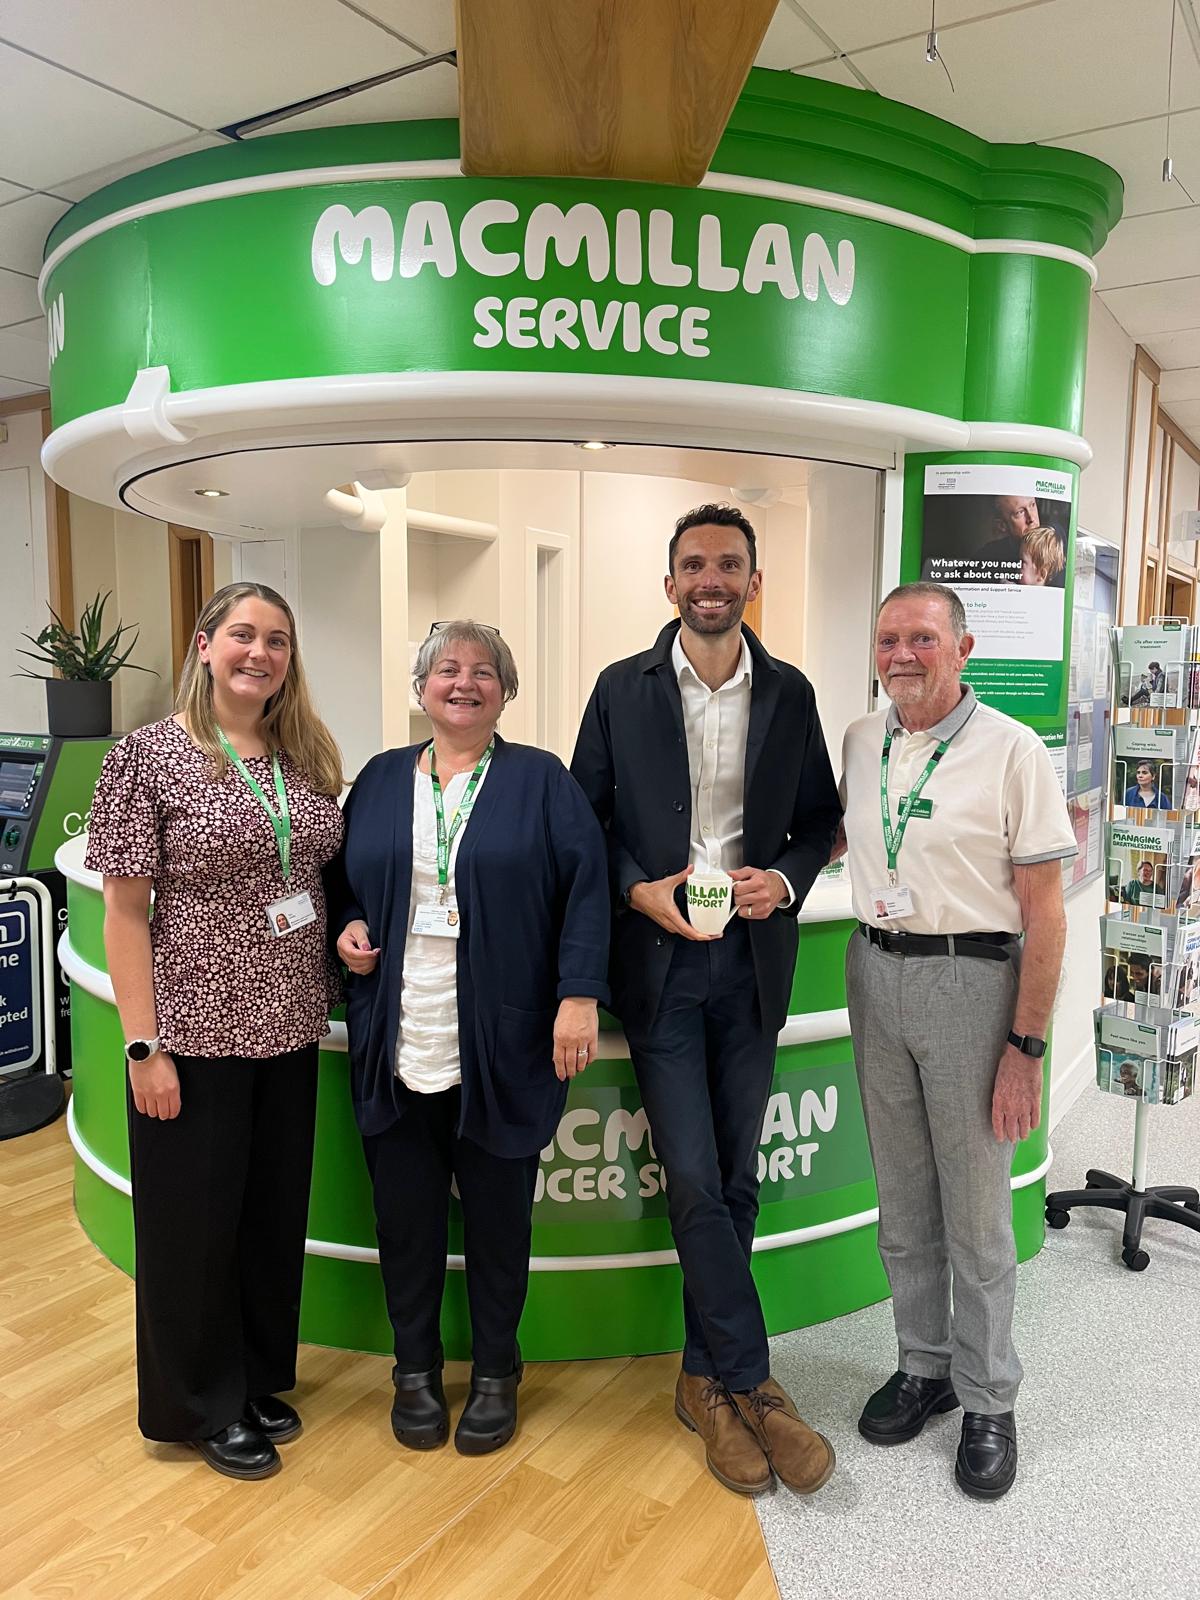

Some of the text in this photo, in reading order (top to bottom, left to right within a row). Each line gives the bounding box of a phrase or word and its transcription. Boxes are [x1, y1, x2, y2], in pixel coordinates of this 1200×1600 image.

[311, 199, 856, 305] MACMILLAN
[472, 296, 711, 357] SERVICE
[1036, 480, 1066, 490] MACMILLAN
[931, 558, 980, 567] Whatever
[1001, 560, 1022, 568] need
[944, 570, 960, 578] ask
[964, 570, 992, 578] about
[1113, 833, 1161, 844] MANAGING
[1113, 841, 1162, 851] BREATHLESSNESS
[0, 1007, 28, 1028] pted
[638, 1164, 667, 1198] S
